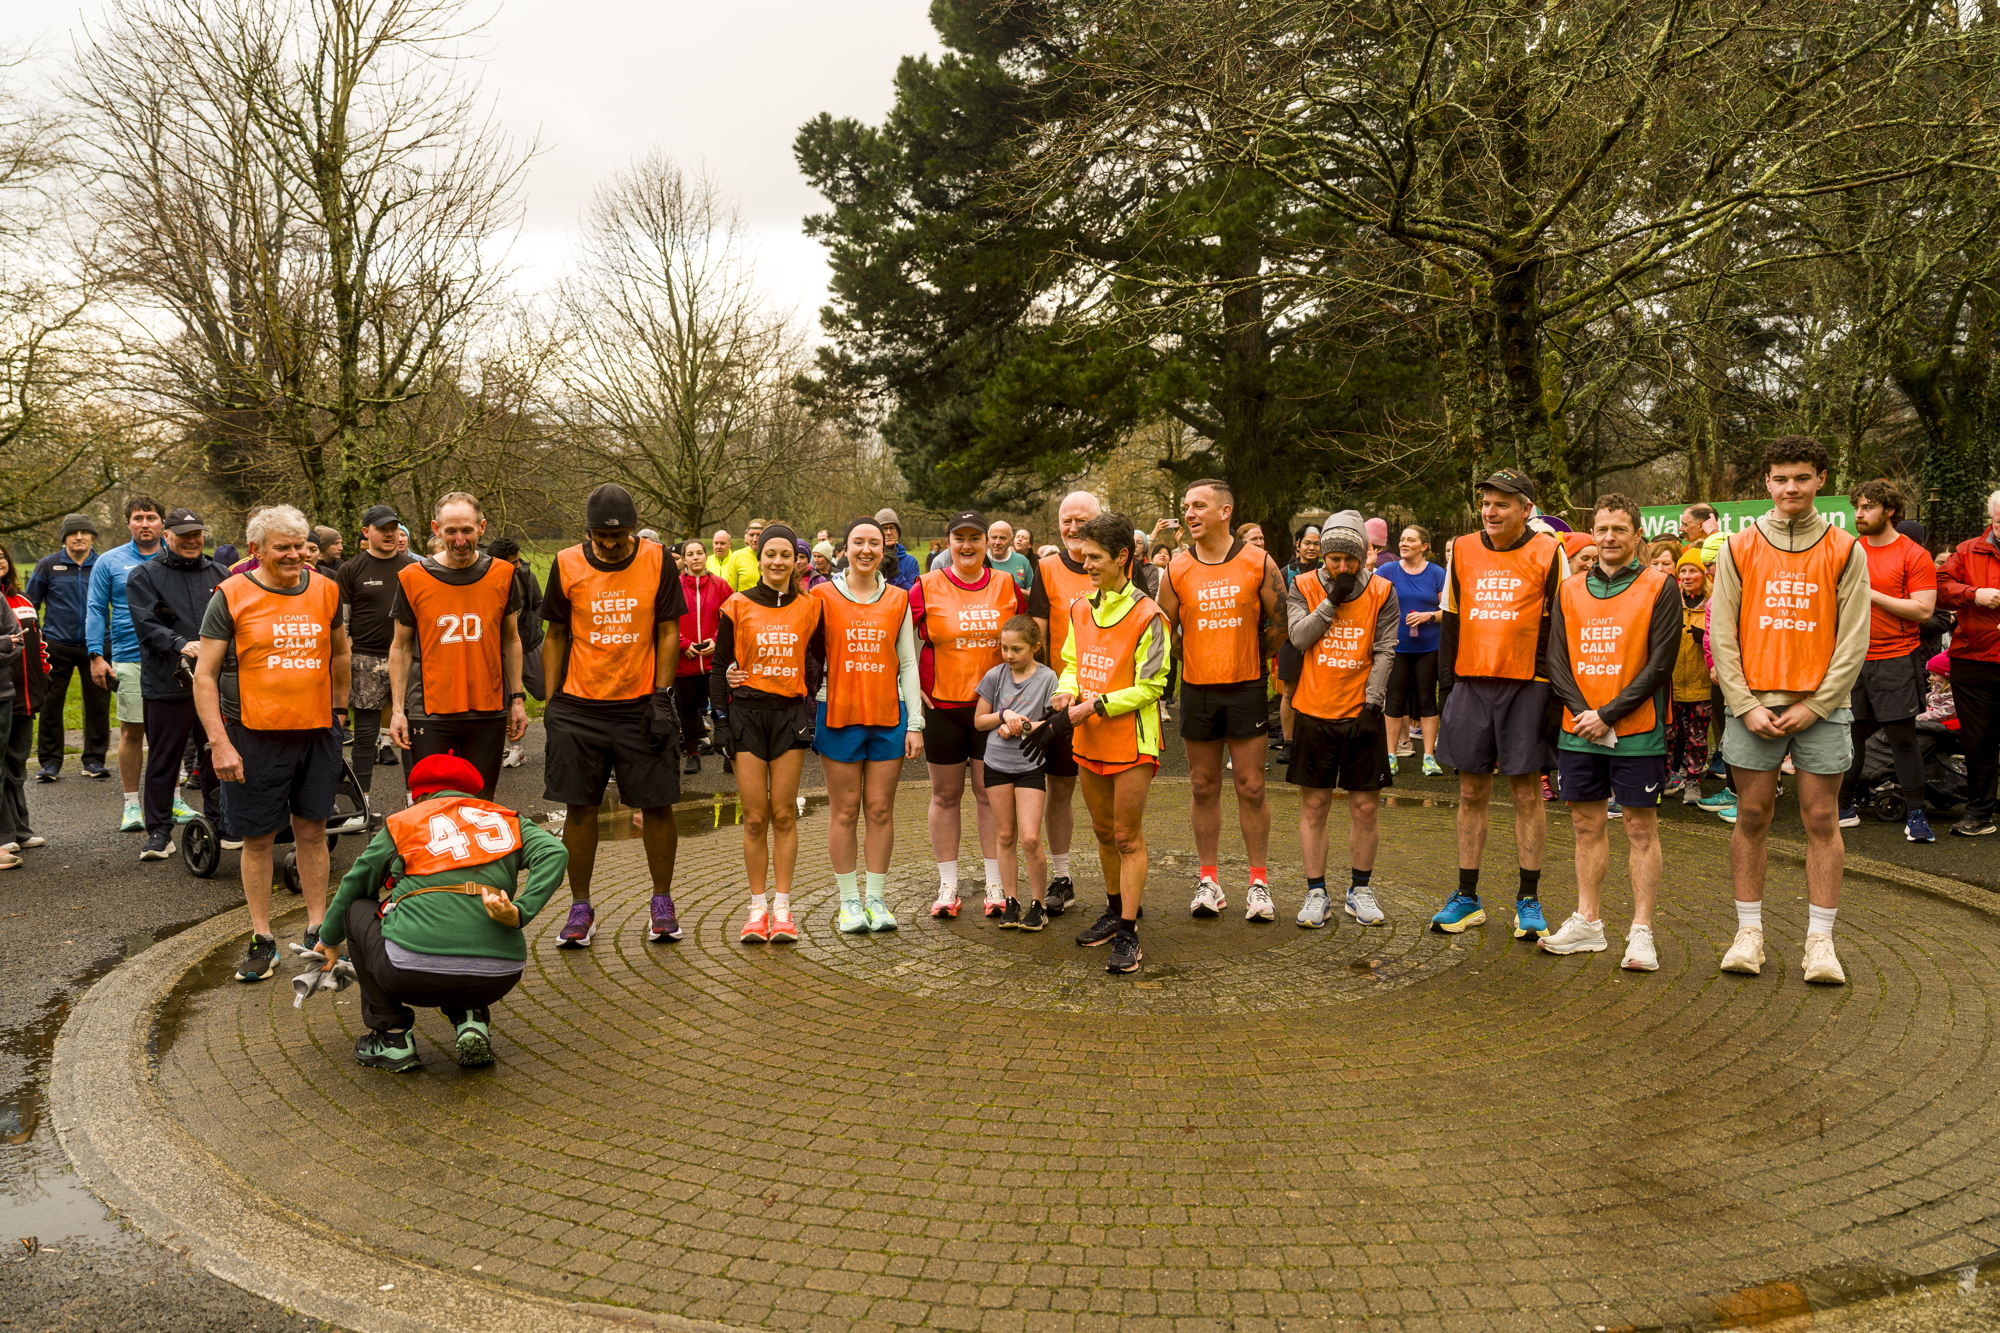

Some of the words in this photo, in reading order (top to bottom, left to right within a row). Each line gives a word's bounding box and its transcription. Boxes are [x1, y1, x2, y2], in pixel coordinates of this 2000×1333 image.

[1778, 571, 1806, 581] CAN'T
[1207, 579, 1229, 588] CAN'T
[1476, 577, 1522, 590] KEEP
[1765, 580, 1819, 596] KEEP
[602, 590, 626, 598] CAN'T
[1197, 585, 1241, 601] KEEP
[1475, 591, 1513, 602] CALM
[591, 598, 638, 613] KEEP
[1199, 598, 1236, 612] CALM
[1764, 596, 1810, 609] CALM
[592, 613, 632, 625] CALM
[958, 610, 1001, 621] KEEP
[1469, 608, 1519, 621] Pacer
[959, 621, 998, 631] CALM
[1197, 616, 1243, 631] Pacer
[1591, 617, 1614, 626] CAN'T
[1759, 615, 1816, 632] Pacer
[272, 623, 323, 636] KEEP
[437, 613, 483, 645] 20
[846, 628, 887, 641] KEEP
[1580, 626, 1623, 640] KEEP
[273, 638, 317, 648] CALM
[590, 631, 639, 644] Pacer
[756, 632, 799, 645] KEEP
[1322, 638, 1358, 650] CALM
[758, 646, 793, 657] CALM
[847, 642, 880, 653] CALM
[1580, 642, 1616, 654] CALM
[267, 655, 322, 669] Pacer
[845, 660, 885, 673] Pacer
[1082, 652, 1114, 670] KEEP
[1317, 654, 1363, 669] Pacer
[752, 663, 798, 677] Pacer
[1577, 661, 1622, 675] Pacer
[1080, 667, 1107, 683] CALM
[1095, 682, 1100, 690] A
